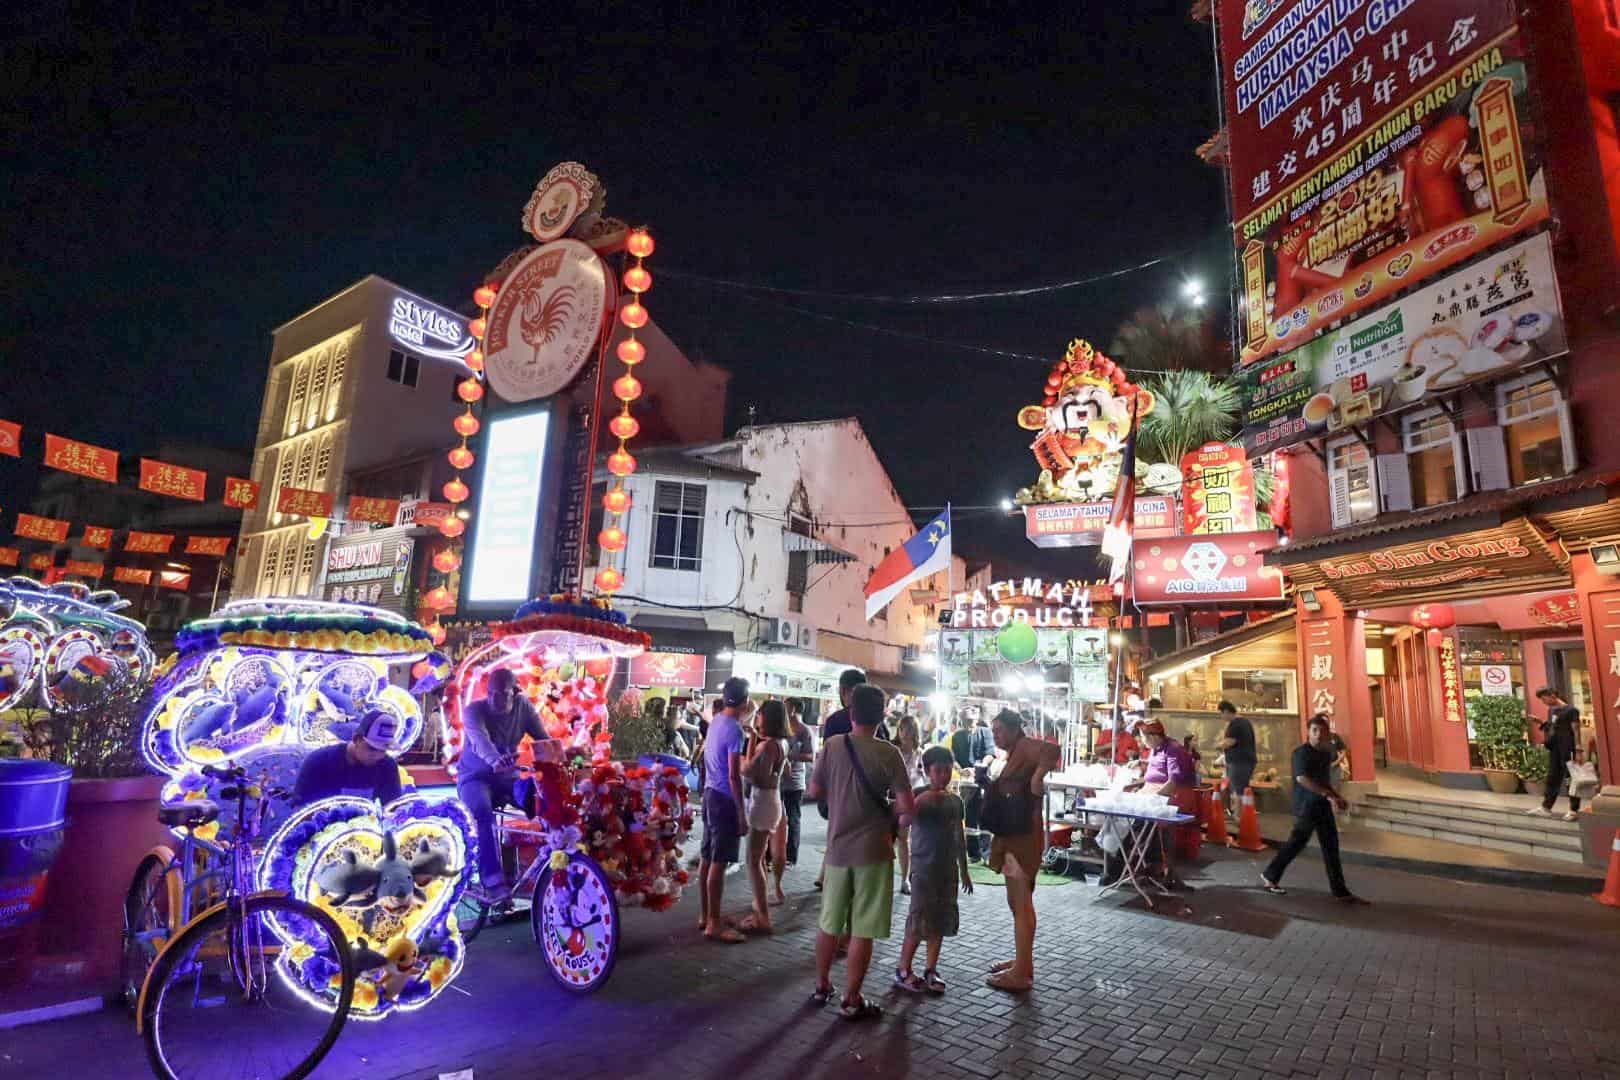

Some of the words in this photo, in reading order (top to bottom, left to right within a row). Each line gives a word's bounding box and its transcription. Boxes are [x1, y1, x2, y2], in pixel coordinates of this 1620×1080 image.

[1235, 4, 1302, 81] SAMBUTAN
[1237, 4, 1333, 114] HUBUNGAN
[1260, 27, 1354, 129] MALAYSIA
[1243, 194, 1289, 240] SELAMAT
[1292, 144, 1364, 208] MENYAMBUT
[1366, 108, 1412, 155] TAHUN
[1414, 79, 1458, 125] BARU
[1462, 46, 1503, 86] CINA
[1352, 322, 1399, 349] Nutrition
[1247, 395, 1293, 420] TONGKAT
[1295, 386, 1313, 401] ALI
[229, 481, 254, 504] 福
[1036, 507, 1078, 521] SELAMAT
[1142, 501, 1167, 513] CINA
[1320, 560, 1376, 580] San
[1371, 549, 1433, 572] Shu
[1428, 536, 1530, 563] Gong
[954, 577, 1091, 610] FATIMAH
[954, 606, 1093, 627] PRODUCT
